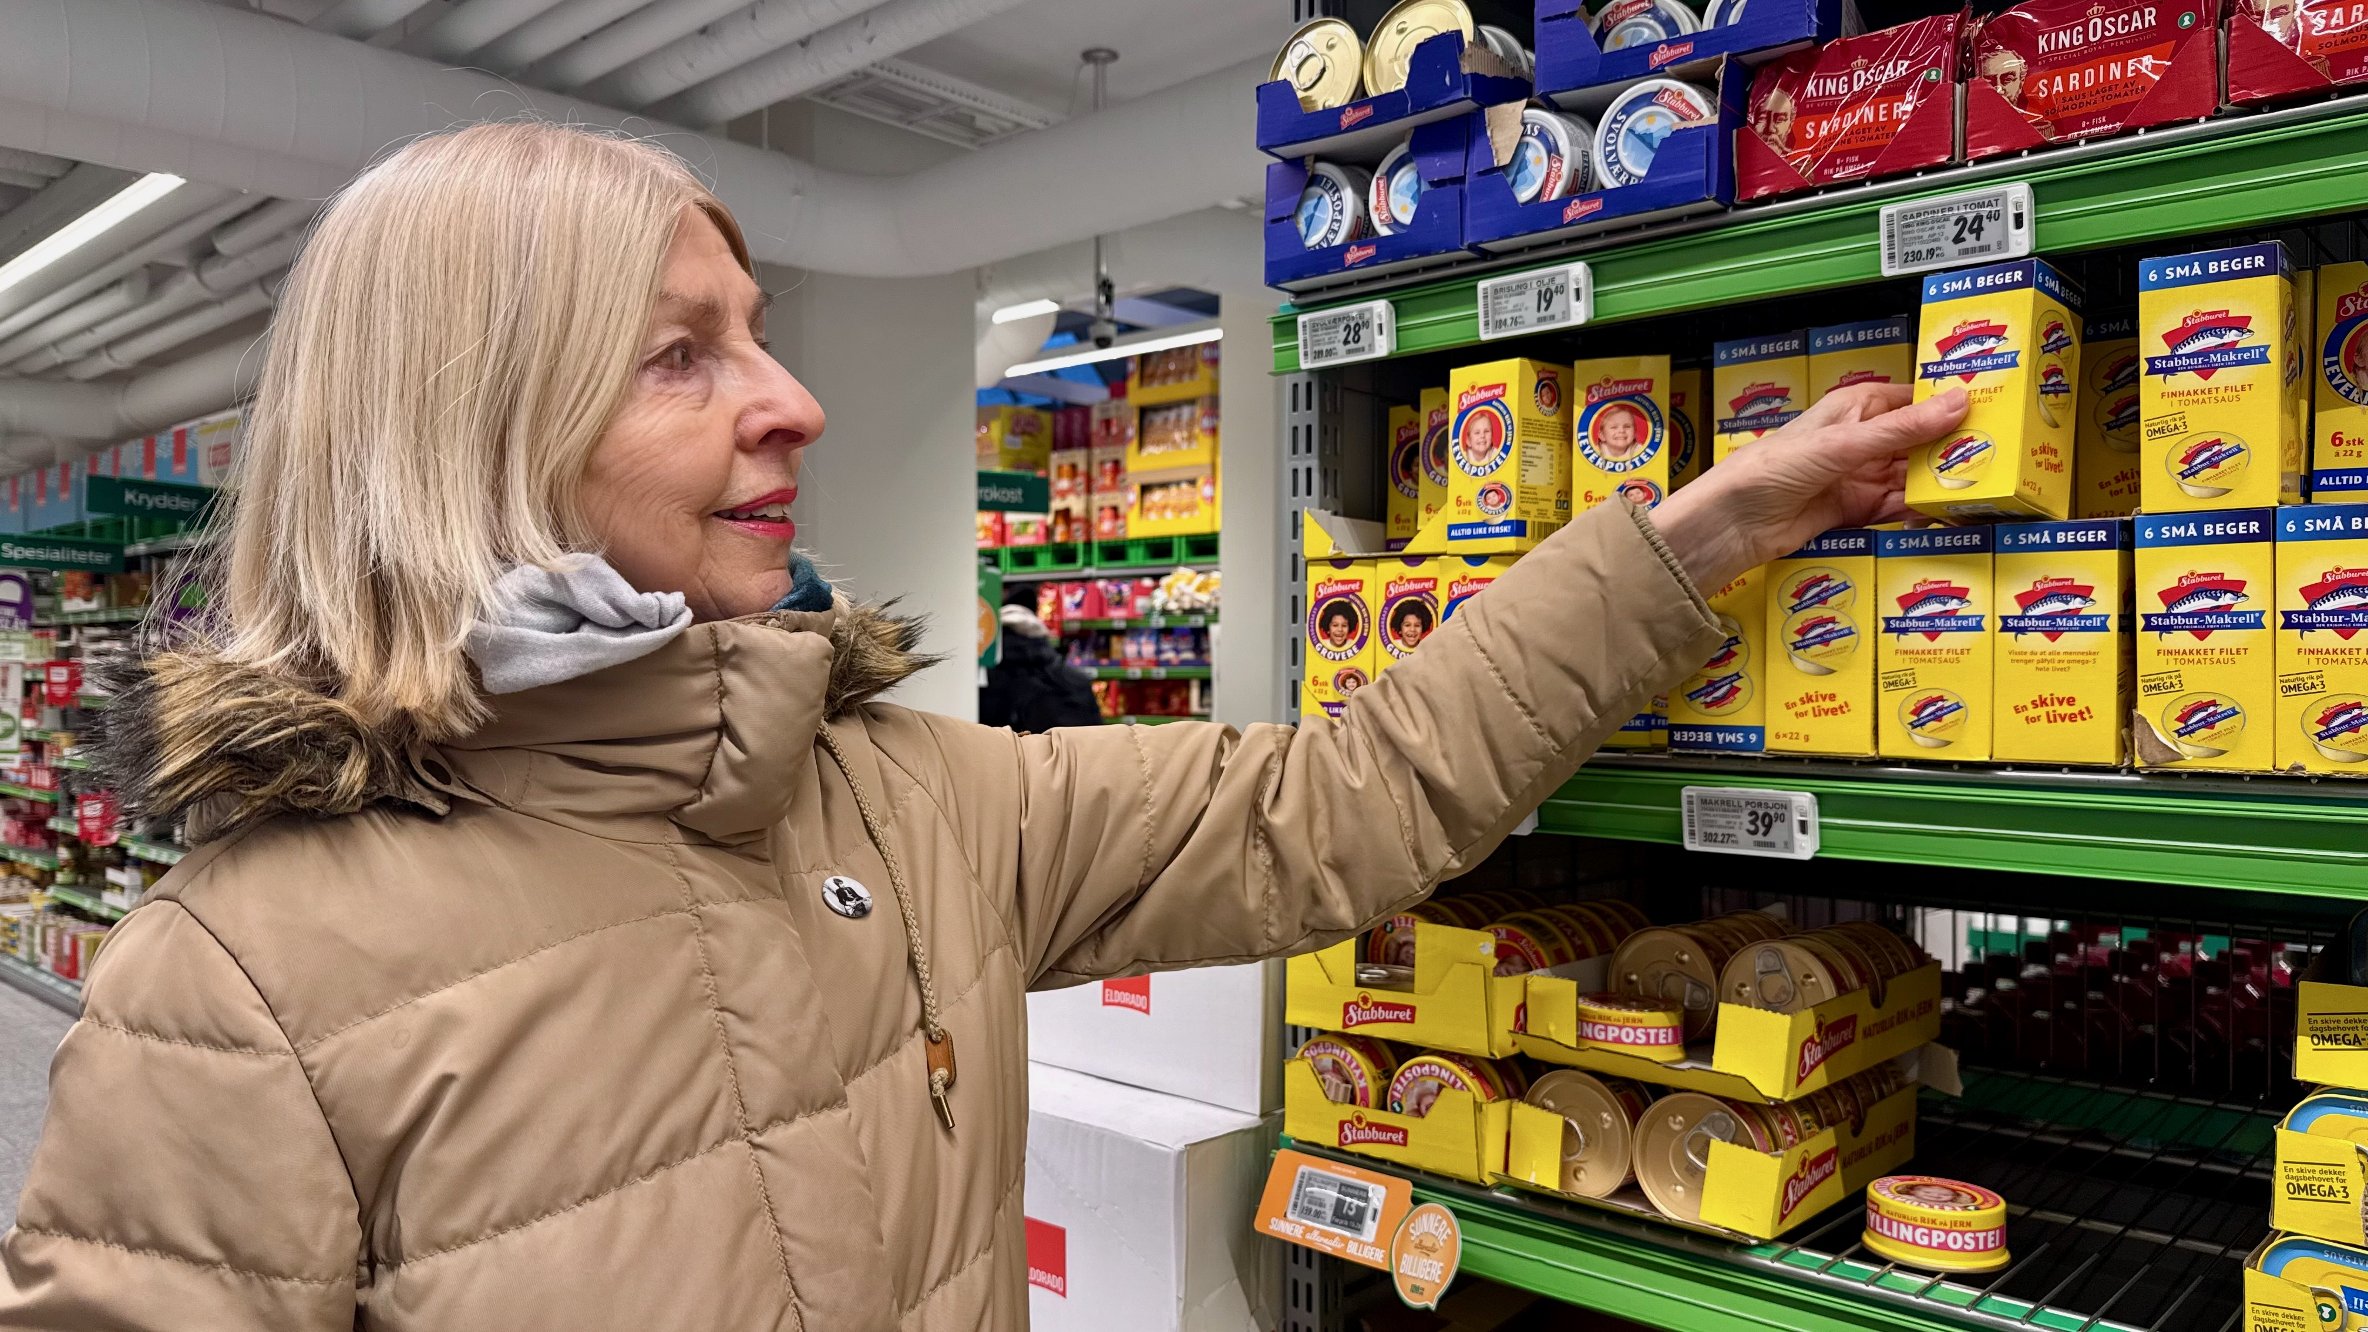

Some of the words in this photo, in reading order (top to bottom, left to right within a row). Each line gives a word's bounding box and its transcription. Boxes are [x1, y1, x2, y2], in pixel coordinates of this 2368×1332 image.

[1605, 0, 1651, 27] Stabburet
[2038, 26, 2084, 54] KING
[2088, 7, 2157, 43] OSCAR
[1651, 44, 1691, 65] Stabburet
[1806, 76, 1849, 98] KING
[1852, 60, 1909, 92] OSCAR
[2038, 55, 2153, 98] SARDINER
[1658, 91, 1699, 121] Stabburet
[2044, 98, 2100, 116] SOLMODNE
[2101, 86, 2146, 104] TOMATER
[1805, 102, 1903, 139] SARDINER
[1952, 213, 1984, 245] 24
[1986, 210, 2000, 222] 40
[2149, 270, 2157, 281] 6
[2165, 262, 2202, 280] SMÅ
[2208, 255, 2265, 274] BEGER
[1929, 284, 1937, 296] 6
[1942, 277, 1972, 294] SMÅ
[1977, 270, 2023, 288] BEGER
[2038, 273, 2043, 283] 6
[2044, 276, 2060, 294] SMÅ
[2061, 286, 2082, 307] BEGER
[1536, 287, 1554, 313] 19
[1554, 284, 1565, 296] 40
[2184, 312, 2227, 328] Stabburet
[1343, 322, 1361, 346] 28
[1815, 337, 1822, 348] 6
[1827, 331, 1853, 346] SMÅ
[1858, 327, 1900, 341] BEGER
[1720, 350, 1727, 360] 6
[1731, 343, 1757, 358] SMÅ
[1761, 339, 1799, 354] BEGER
[1460, 385, 1504, 408] Stabburet
[1588, 380, 1649, 402] Stabburet
[1980, 386, 2004, 396] FILET
[2161, 387, 2220, 399] FINHAKKET
[2224, 384, 2253, 393] FILET
[2145, 418, 2168, 429] Naturlig
[2179, 414, 2186, 423] på
[2146, 421, 2188, 438] OMEGA-3
[2331, 431, 2343, 447] 6
[2346, 437, 2364, 446] stk
[1452, 438, 1508, 476] LEVERPOSTEI
[1578, 432, 1654, 472] LEVERPOSTEI
[2031, 447, 2037, 456] En
[2039, 443, 2058, 457] skive
[2320, 475, 2362, 486] ALLTID
[124, 488, 199, 511] Krydder
[1584, 491, 1593, 503] 6
[1450, 528, 1472, 536] ALLTID
[1473, 527, 1486, 535] LIKE
[2145, 529, 2153, 539] 6
[2161, 523, 2198, 538] SMÅ
[2203, 521, 2260, 535] BEGER
[2286, 520, 2296, 532] 6
[2305, 516, 2344, 531] SMÅ
[1821, 538, 1866, 550] BEGER
[1886, 538, 1893, 549] 6
[1900, 535, 1930, 548] SMÅ
[1935, 534, 1981, 547] BEGER
[2003, 534, 2012, 545] 6
[2018, 530, 2051, 544] SMÅ
[2056, 530, 2107, 543] BEGER
[1, 542, 113, 565] Spesialiteter
[1386, 580, 1434, 597] Stabburet
[1914, 581, 1949, 593] Stabburet
[2034, 579, 2072, 592] Stabburet
[2179, 574, 2222, 587] Stabburet
[1315, 582, 1360, 598] Stabburet
[1315, 642, 1359, 660] GROVERE
[1895, 648, 1943, 656] FINHAKKET
[2157, 648, 2215, 656] FINHAKKET
[2219, 647, 2248, 656] FILET
[2297, 647, 2362, 656] FINHAKKET
[1882, 676, 1917, 689] OMEGA-3
[2142, 680, 2184, 693] OMEGA-3
[2279, 675, 2303, 685] Naturlig
[2304, 674, 2315, 682] rik
[2315, 674, 2324, 682] på
[2281, 680, 2326, 694] OMEGA-3
[1785, 701, 1797, 710] En
[1799, 691, 1837, 706] skive
[2013, 704, 2028, 715] En
[2030, 693, 2076, 710] skive
[1795, 709, 1808, 719] for
[1812, 701, 1851, 718] livet!
[2025, 713, 2042, 725] for
[2046, 706, 2093, 724] livet!
[1674, 731, 1712, 742] BEGER
[1717, 731, 1744, 745] SMÅ
[1749, 733, 1757, 743] 6
[1700, 799, 1742, 807] MAKRELL
[1745, 801, 1787, 810] PORSJON
[1746, 811, 1773, 837] 39
[1774, 813, 1785, 823] 90
[1105, 989, 1147, 1009] ELDORADO
[1345, 1004, 1412, 1026] Stabburet
[1800, 1025, 1854, 1077] Stabburet
[1341, 1122, 1404, 1145] Stabburet
[2285, 1174, 2334, 1183] dagsbehovet
[2296, 1167, 2316, 1175] skive
[2319, 1168, 2345, 1176] dekker
[1783, 1155, 1836, 1213] Stabburet
[2286, 1182, 2350, 1199] OMEGA-3
[1886, 1209, 1918, 1223] NATURLIG
[1920, 1216, 1938, 1226] RIK
[1950, 1219, 1972, 1228] JERN
[1409, 1213, 1452, 1247] SUNNERE
[1269, 1217, 1305, 1239] SUNNERE
[1346, 1240, 1386, 1263] BILLIGERE
[1400, 1253, 1444, 1284] BILLIGERE
